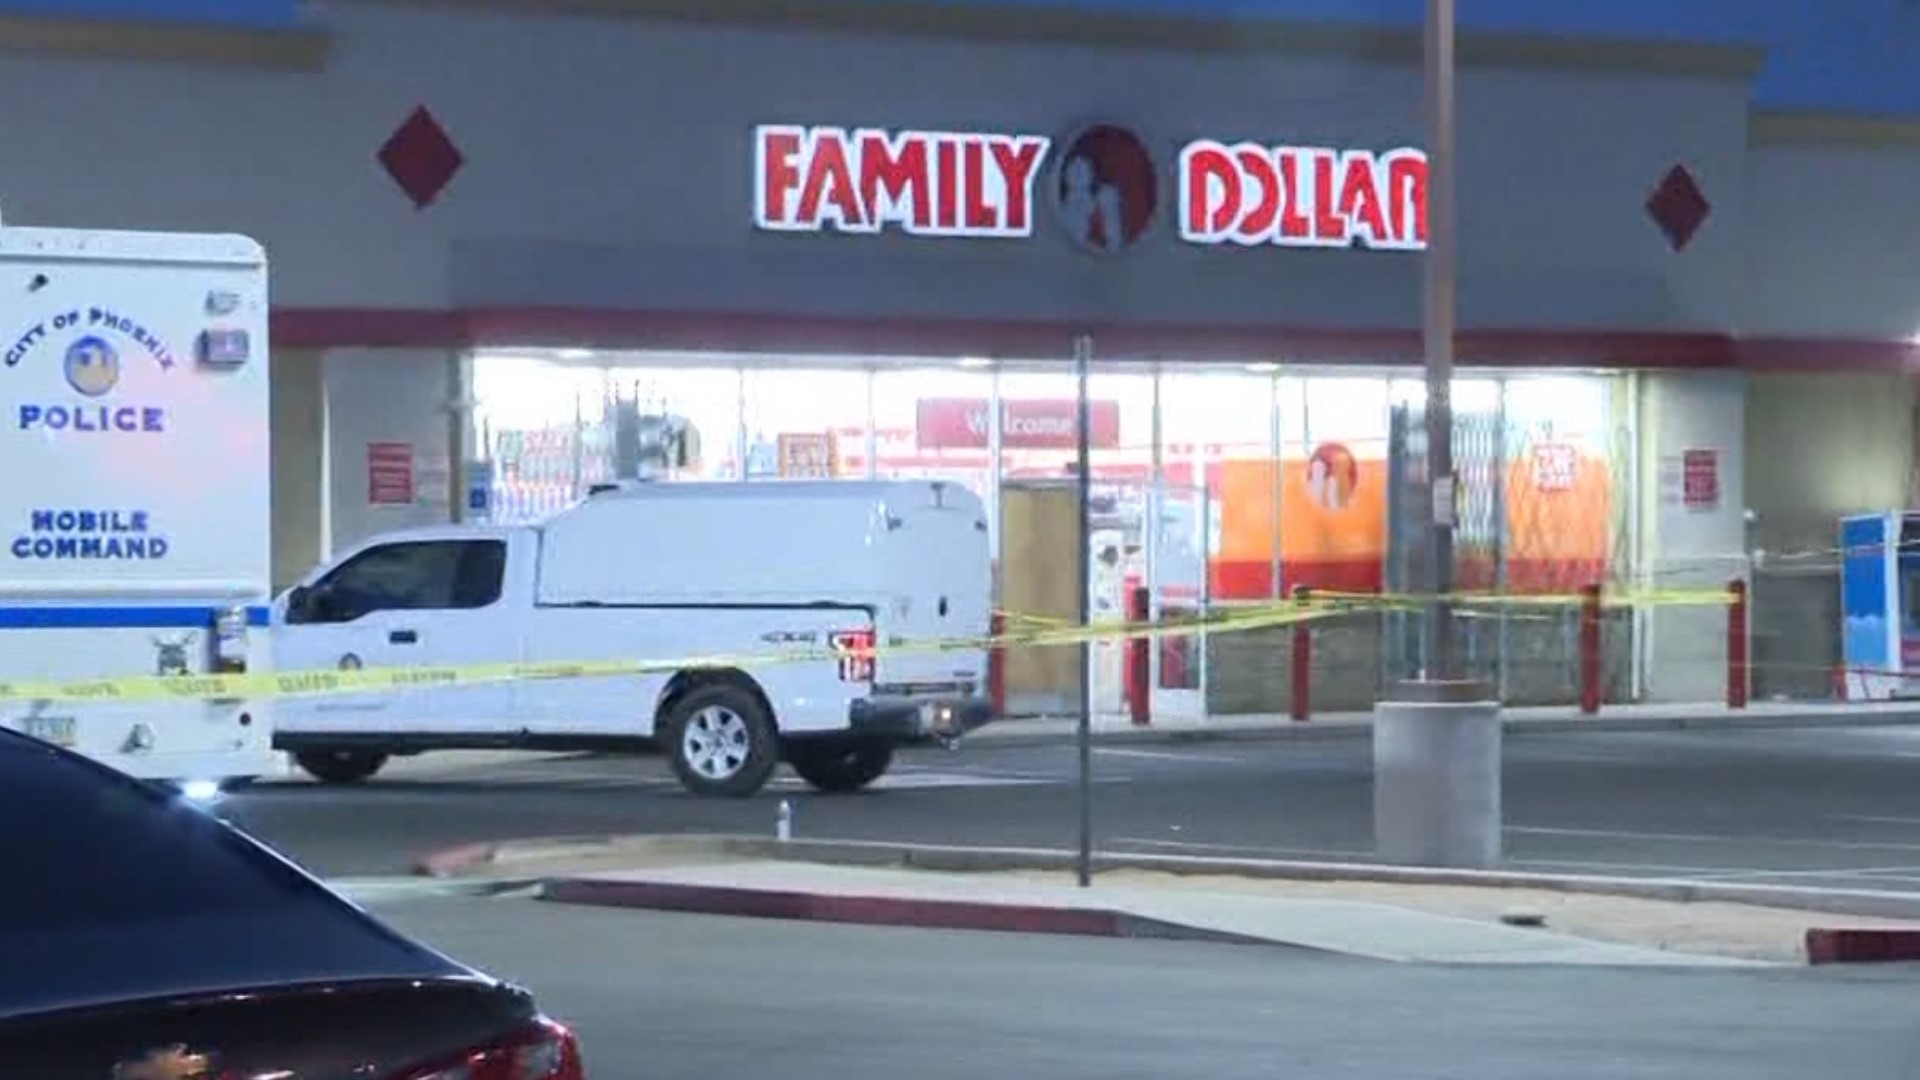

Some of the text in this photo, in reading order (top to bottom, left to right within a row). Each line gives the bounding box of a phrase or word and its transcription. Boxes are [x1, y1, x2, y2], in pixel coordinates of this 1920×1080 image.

[758, 127, 1428, 246] FAMILY DOLLAR
[4, 307, 176, 372] CITY OF PHOENIX
[19, 405, 164, 432] POLICE
[963, 405, 1074, 434] Wlcome
[31, 510, 148, 531] MOBILE
[11, 537, 168, 559] COMMAND
